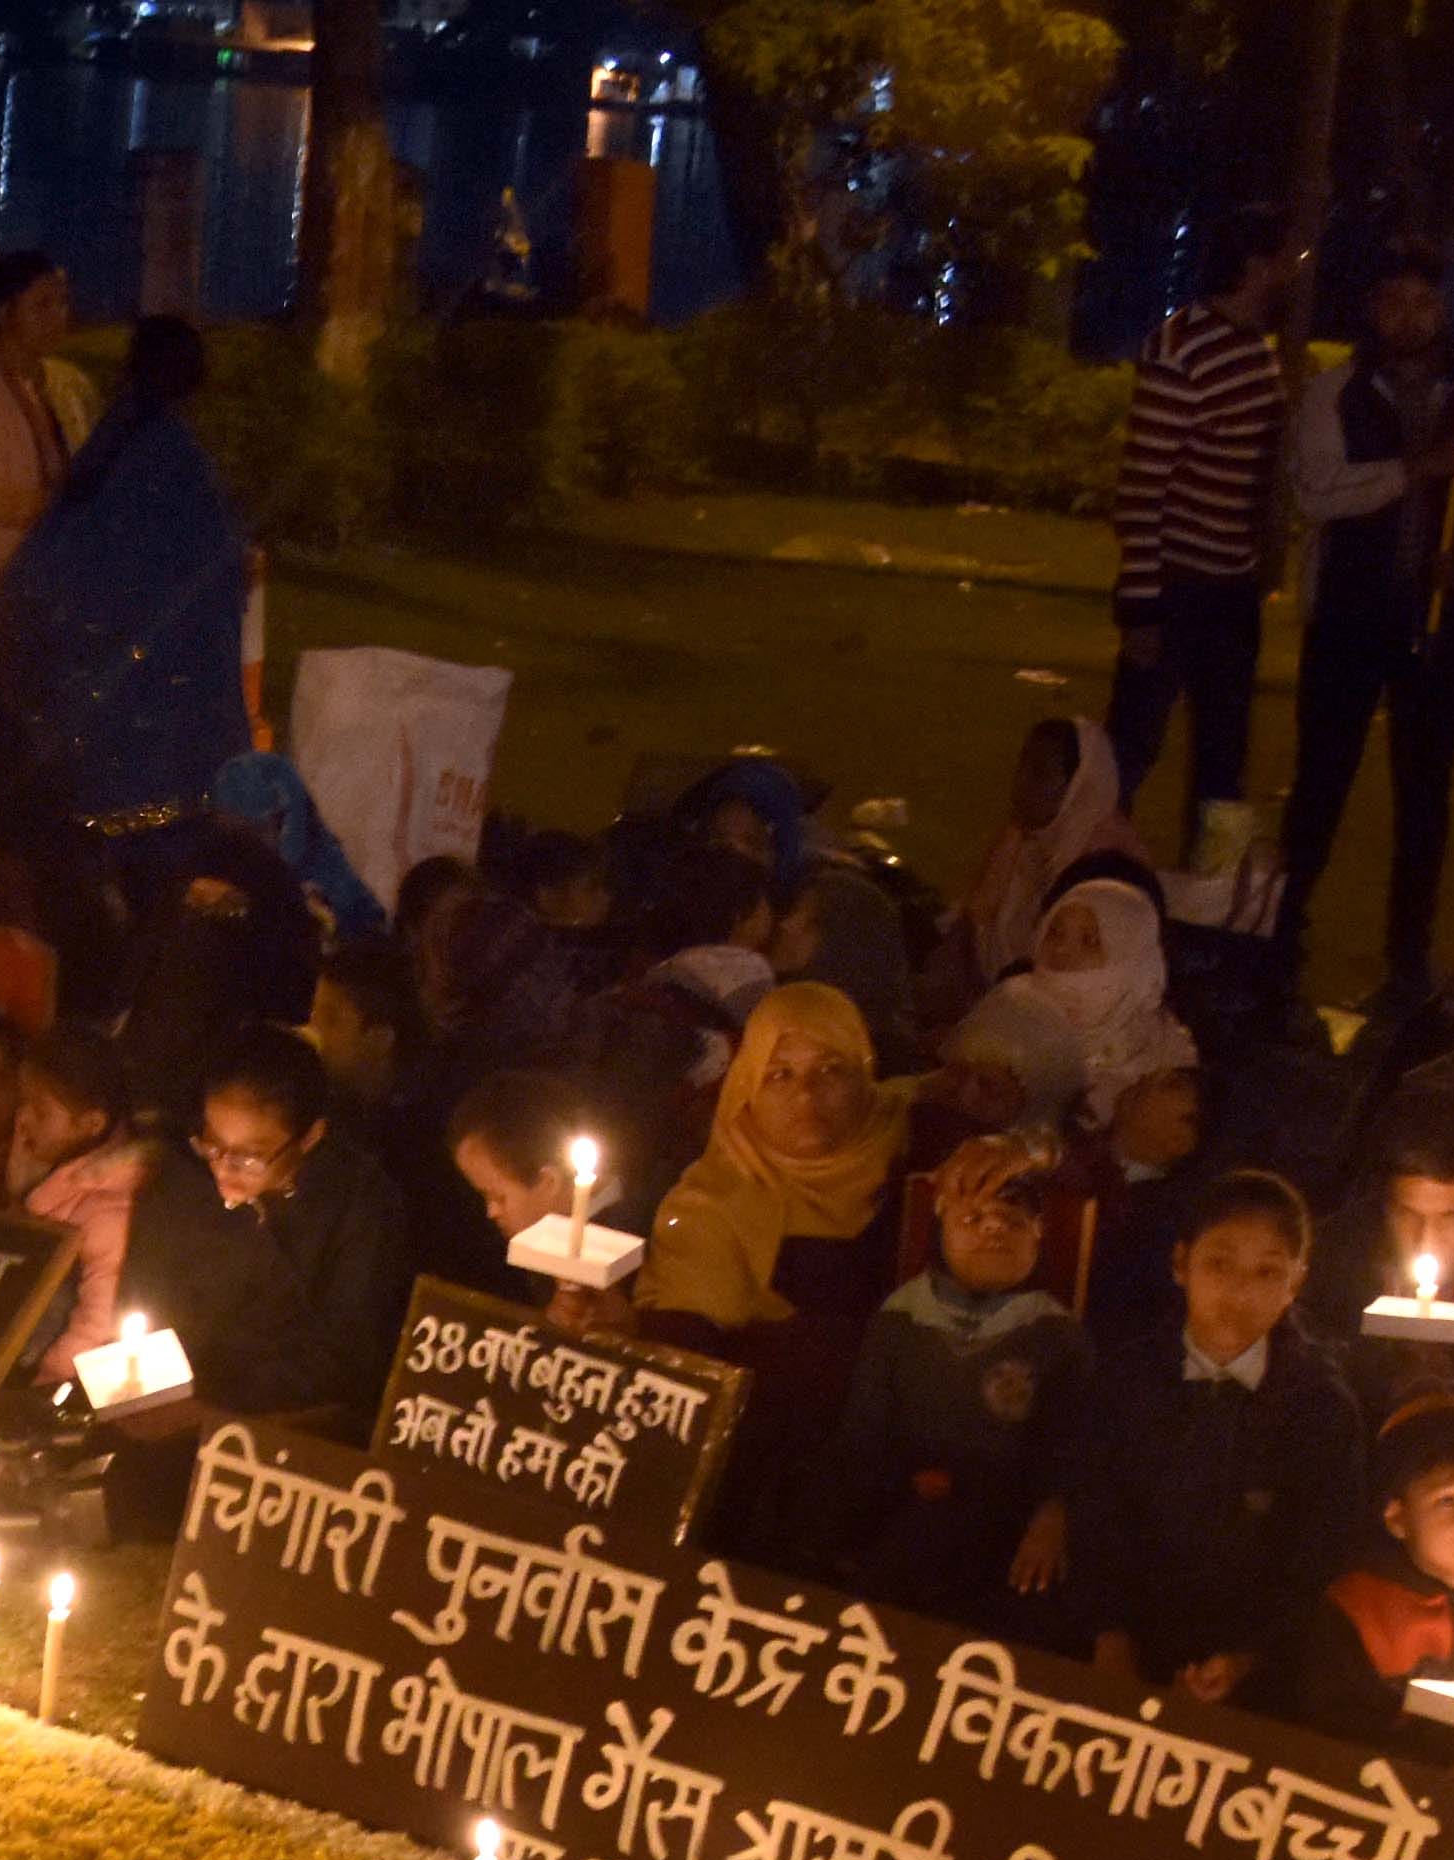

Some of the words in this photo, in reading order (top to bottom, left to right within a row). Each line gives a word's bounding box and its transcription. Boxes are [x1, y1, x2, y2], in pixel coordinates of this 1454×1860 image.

[390, 1393, 463, 1459] अब
[449, 1397, 499, 1475] तो
[496, 1426, 569, 1492] हम
[405, 1315, 468, 1374] 38
[467, 1325, 540, 1393] वर्ष
[528, 1346, 625, 1424] बहुत
[613, 1367, 710, 1445] हुआ
[164, 1570, 227, 1707] के
[381, 1657, 586, 1830] भोपाल
[186, 1422, 406, 1597] चिंगारी
[392, 1523, 666, 1679] पुनर्वास
[825, 1603, 906, 1736] के
[917, 1640, 1252, 1850] विकलांग
